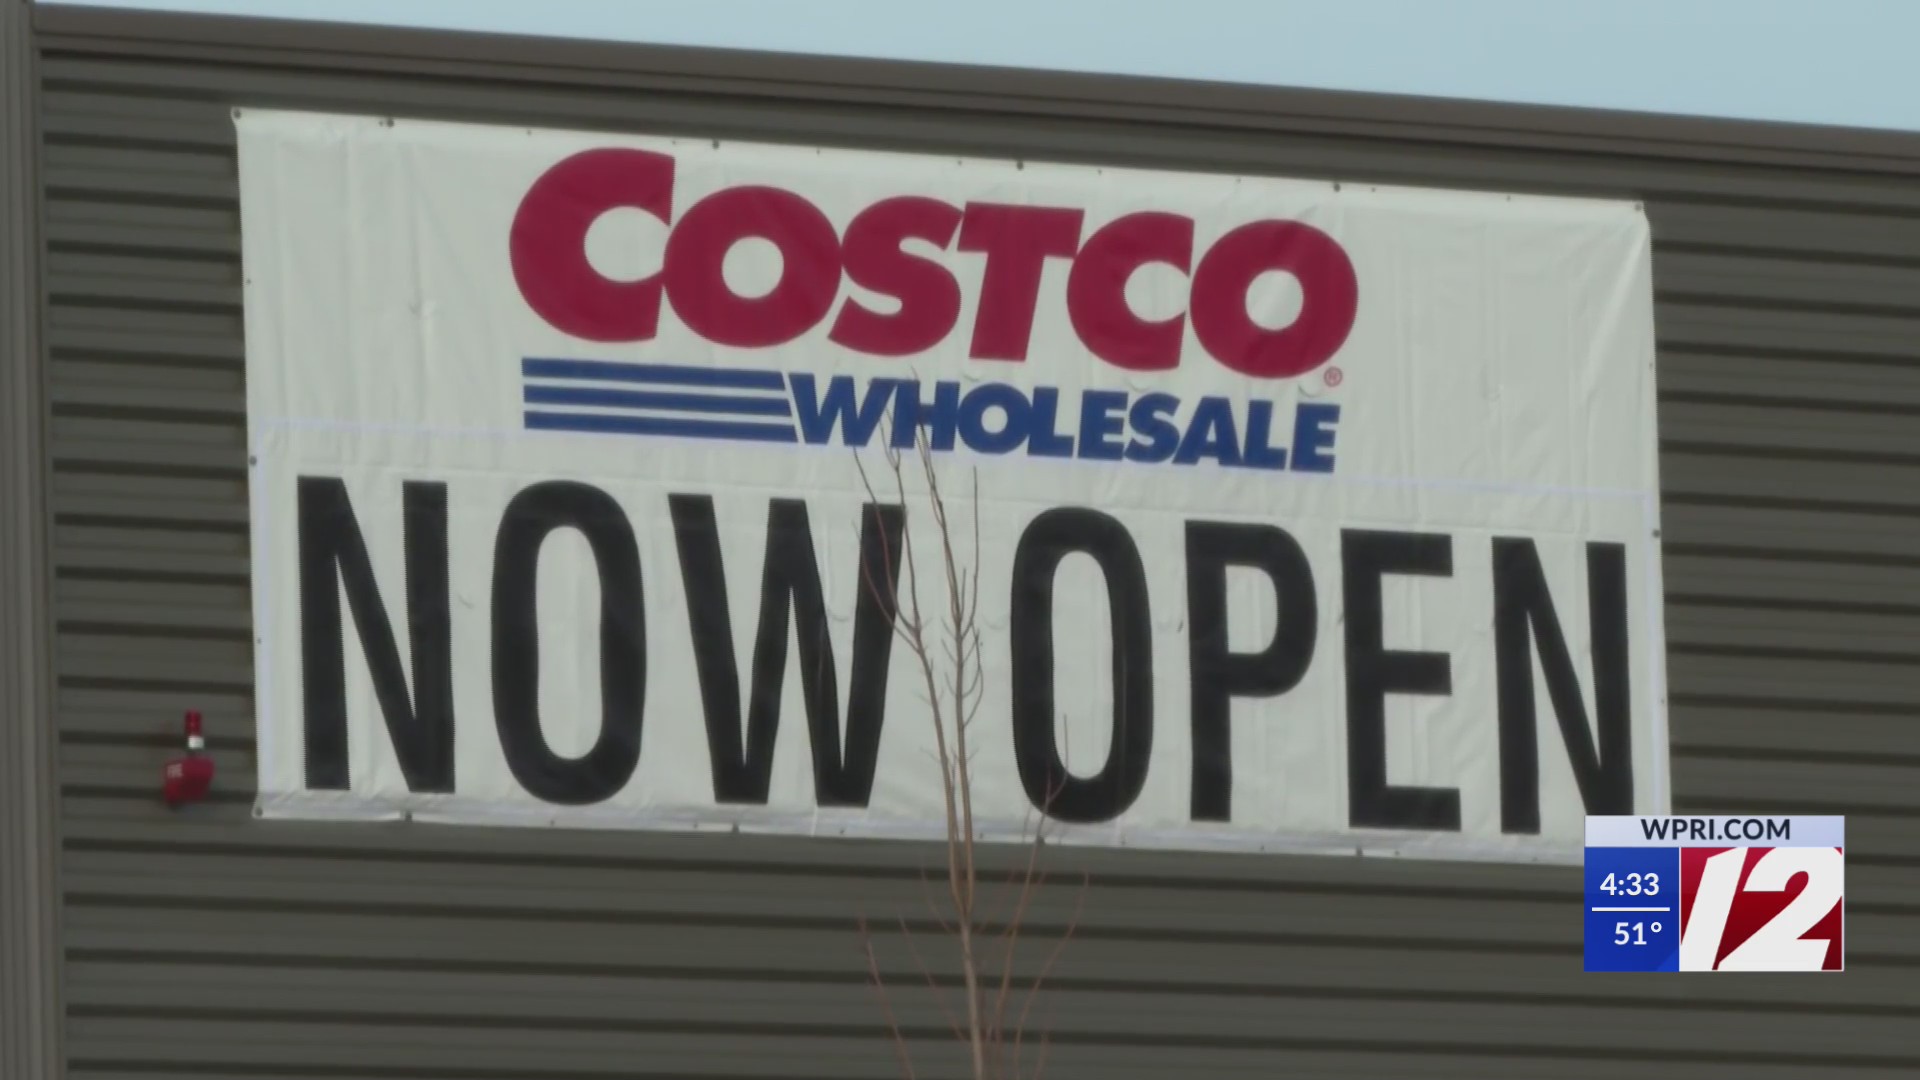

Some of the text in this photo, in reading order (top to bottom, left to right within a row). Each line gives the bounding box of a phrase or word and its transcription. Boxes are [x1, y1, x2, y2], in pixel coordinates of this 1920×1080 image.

[509, 147, 1359, 379] COSTCO
[789, 372, 1341, 473] WHOLESALE
[297, 476, 1634, 834] NOW OPEN
